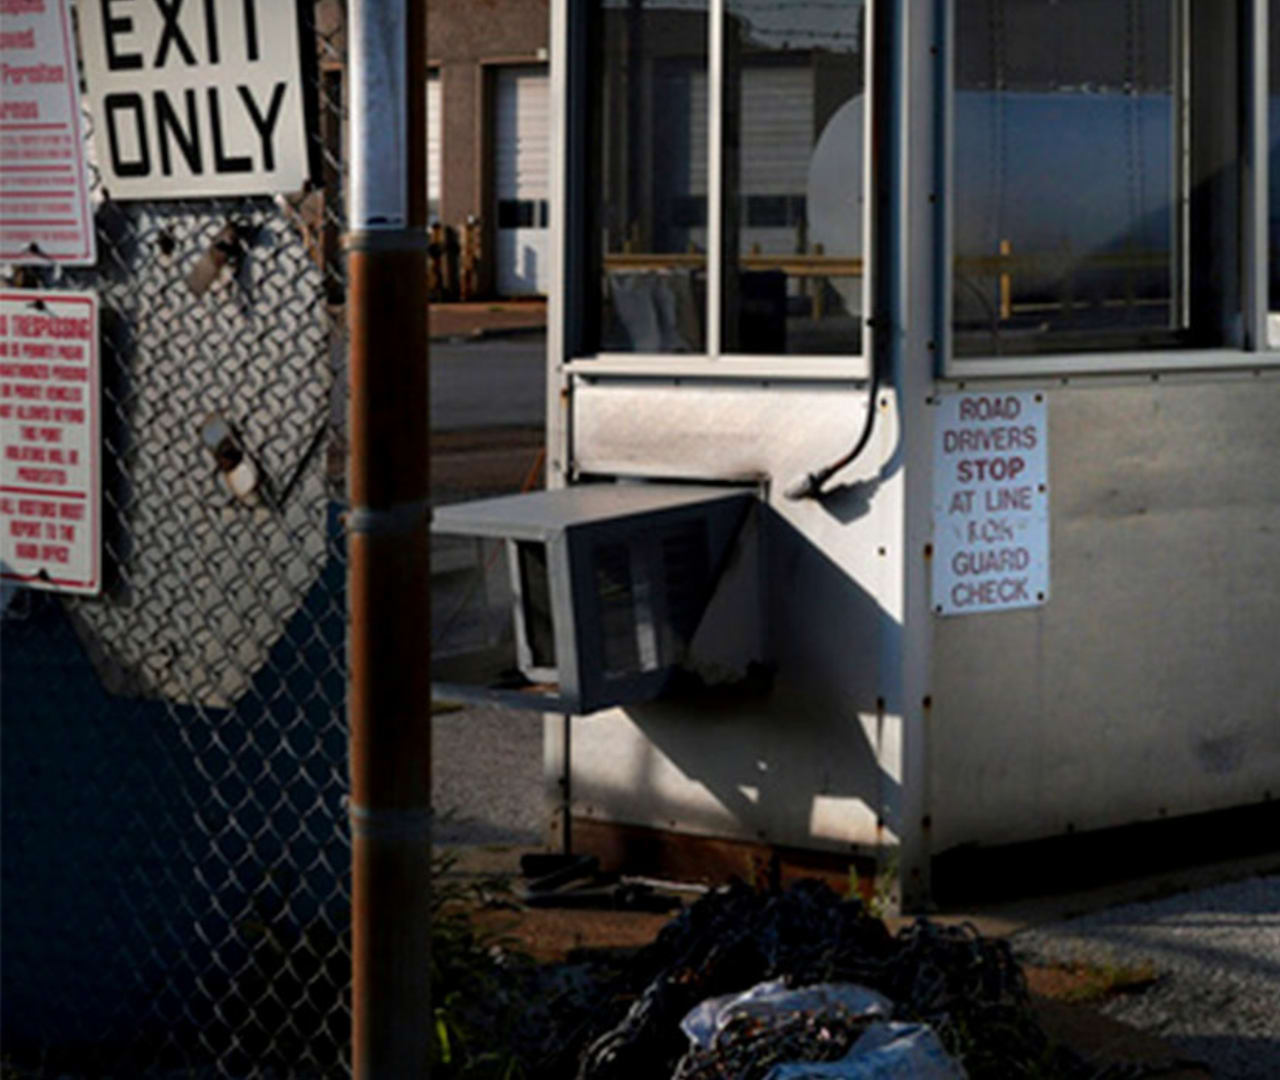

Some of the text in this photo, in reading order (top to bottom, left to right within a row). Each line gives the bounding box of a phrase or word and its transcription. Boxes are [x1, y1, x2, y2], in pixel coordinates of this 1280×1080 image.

[103, 82, 287, 177] ONLY
[959, 395, 1021, 420] ROAD
[943, 426, 1037, 454] DRIVERS
[957, 456, 1025, 483] STOP
[949, 487, 1033, 515] AT LINE
[952, 548, 1029, 576] GUARD
[951, 578, 1030, 607] CHECK
